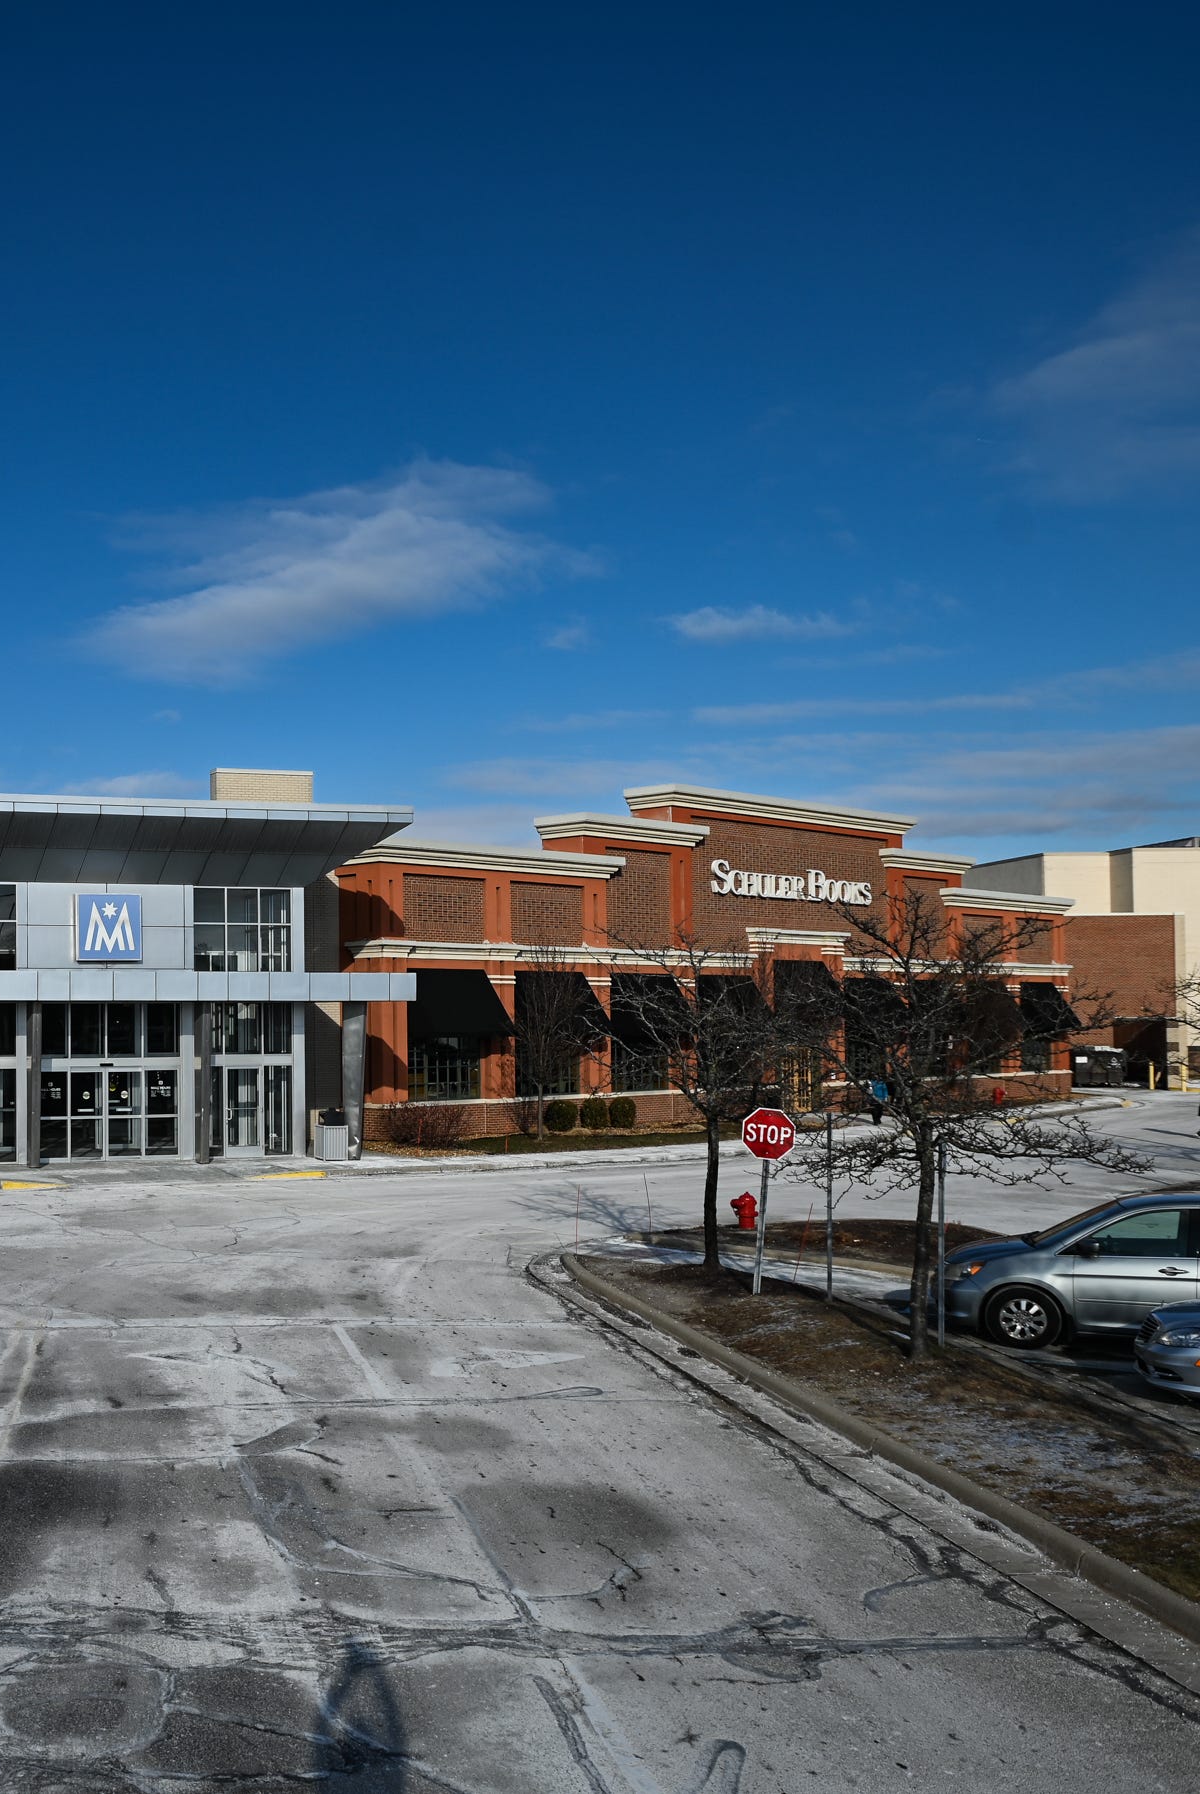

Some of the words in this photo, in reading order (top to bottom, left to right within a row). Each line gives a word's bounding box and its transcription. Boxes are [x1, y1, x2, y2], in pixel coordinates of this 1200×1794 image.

[711, 859, 807, 900] SCHULER
[806, 869, 873, 906] BOOKS
[746, 1123, 792, 1145] STOP
